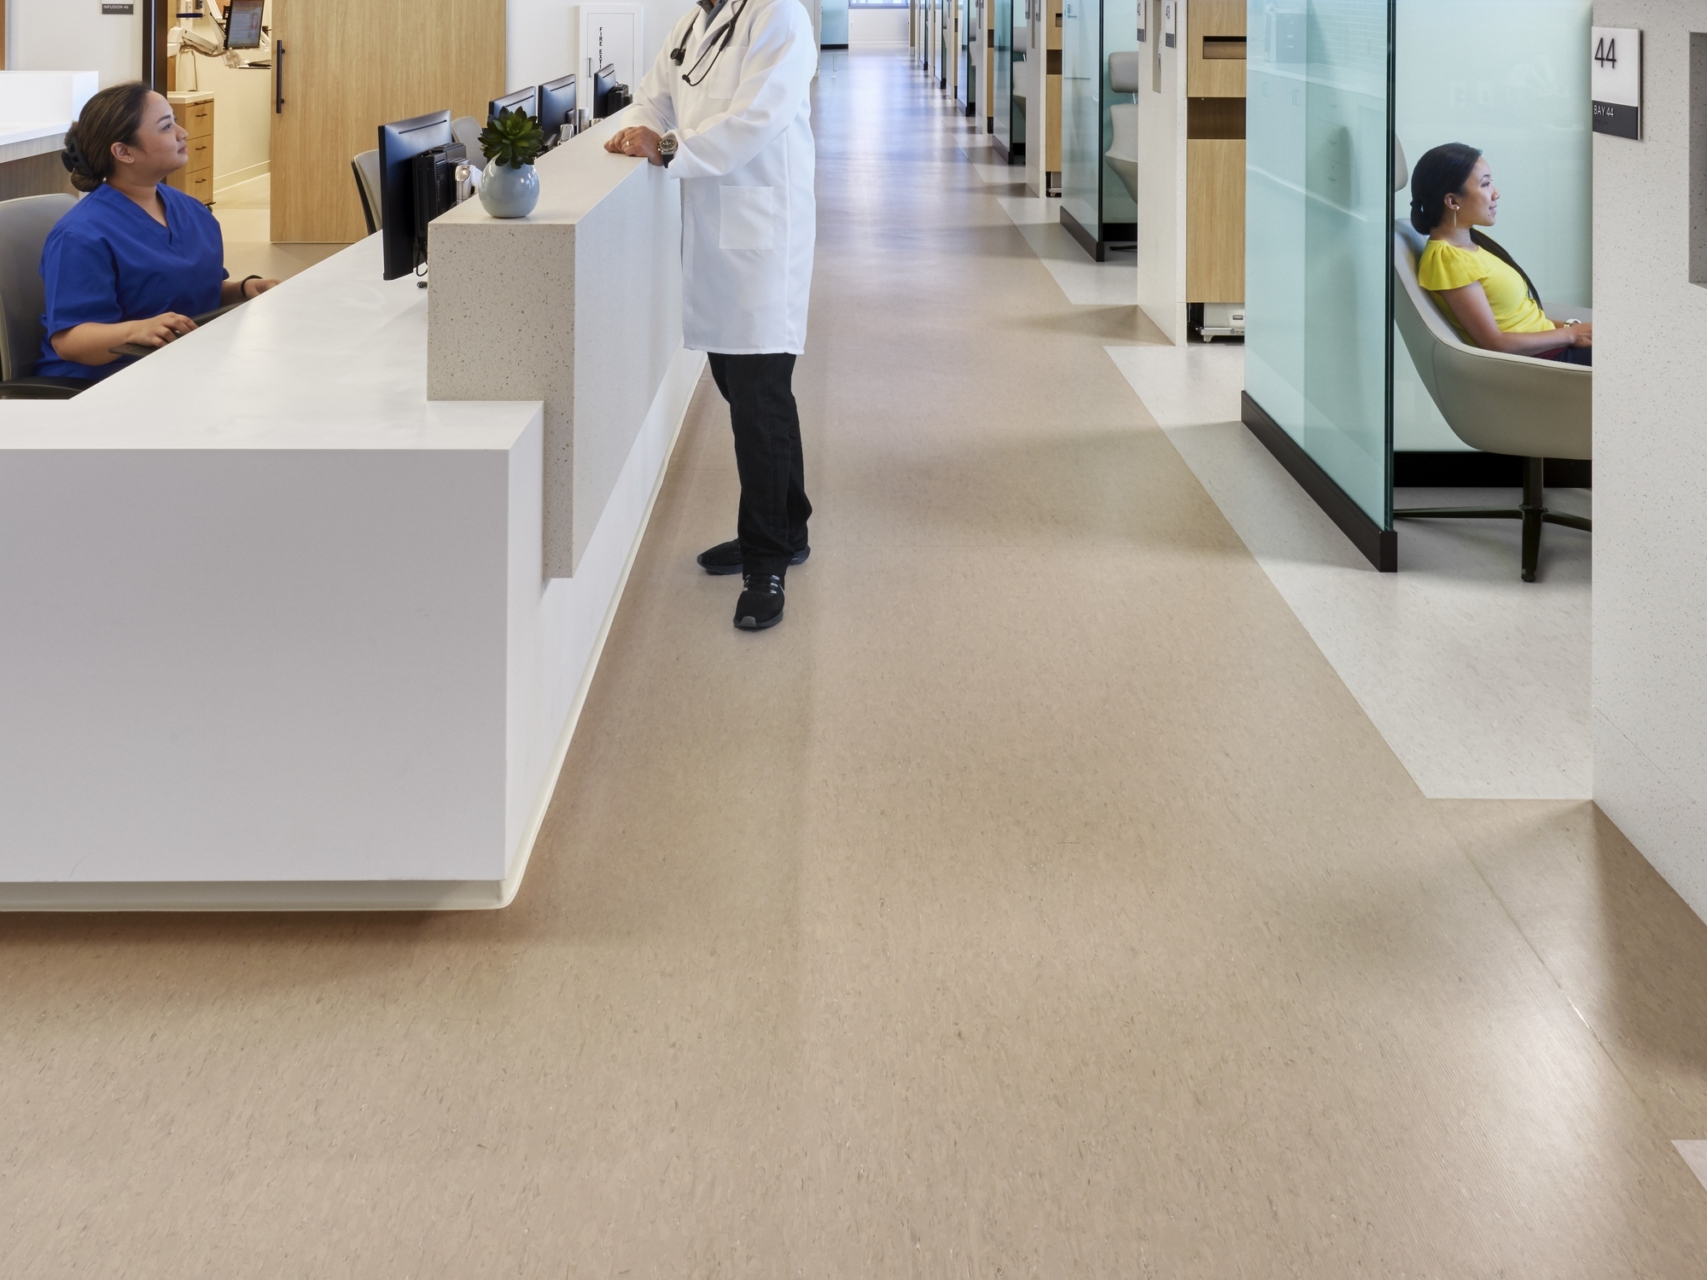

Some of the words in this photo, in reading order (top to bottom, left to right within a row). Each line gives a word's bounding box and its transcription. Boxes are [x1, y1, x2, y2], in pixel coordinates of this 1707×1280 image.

[1594, 37, 1617, 69] 44
[1593, 104, 1606, 117] BAY
[1606, 107, 1614, 118] 44
